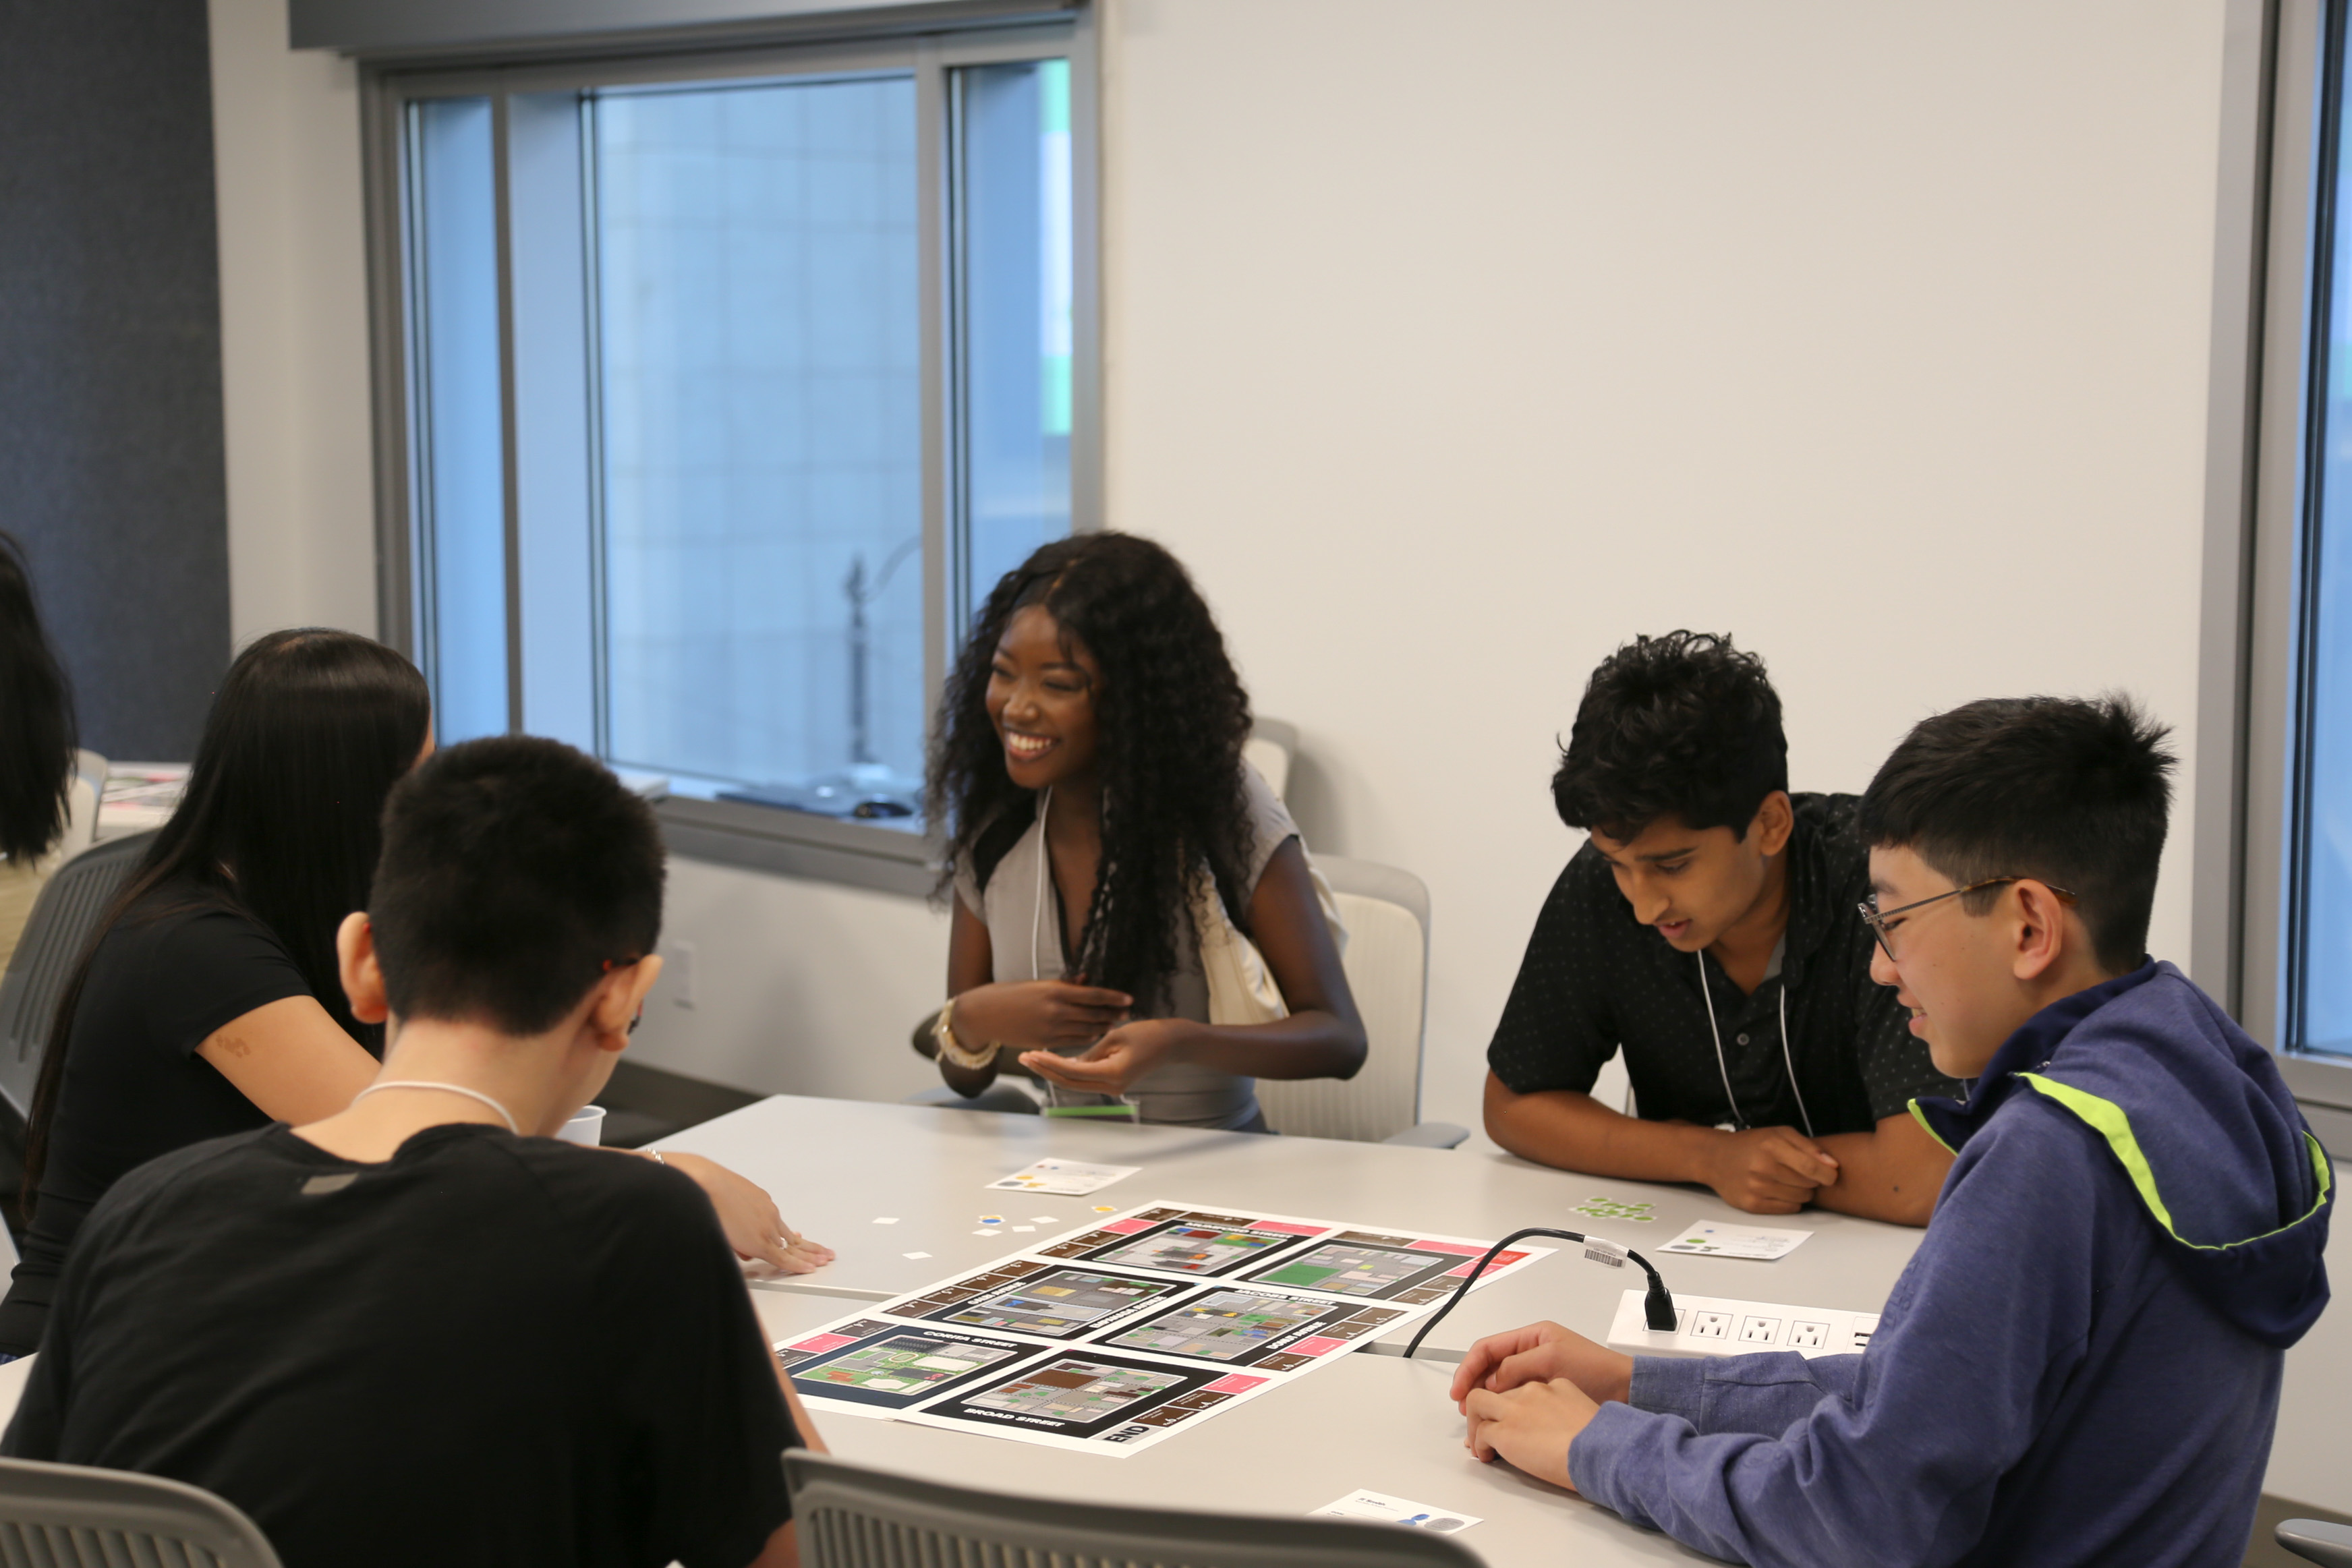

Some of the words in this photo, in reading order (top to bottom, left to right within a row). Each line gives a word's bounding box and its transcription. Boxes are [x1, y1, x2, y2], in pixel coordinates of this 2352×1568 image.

[1250, 1230, 1294, 1238] STREET
[991, 1281, 1027, 1296] AVENUE
[1132, 1296, 1168, 1310] AVENUE
[1235, 1289, 1288, 1300] JACOBS
[1289, 1296, 1336, 1305] STREET
[923, 1331, 970, 1341] CORITA
[971, 1338, 1018, 1347] STREET
[1265, 1335, 1298, 1349] DONUT
[1292, 1321, 1327, 1337] AVENUE
[963, 1408, 1014, 1419] BROAD
[1015, 1416, 1065, 1427] STREET
[1103, 1426, 1150, 1443] END
